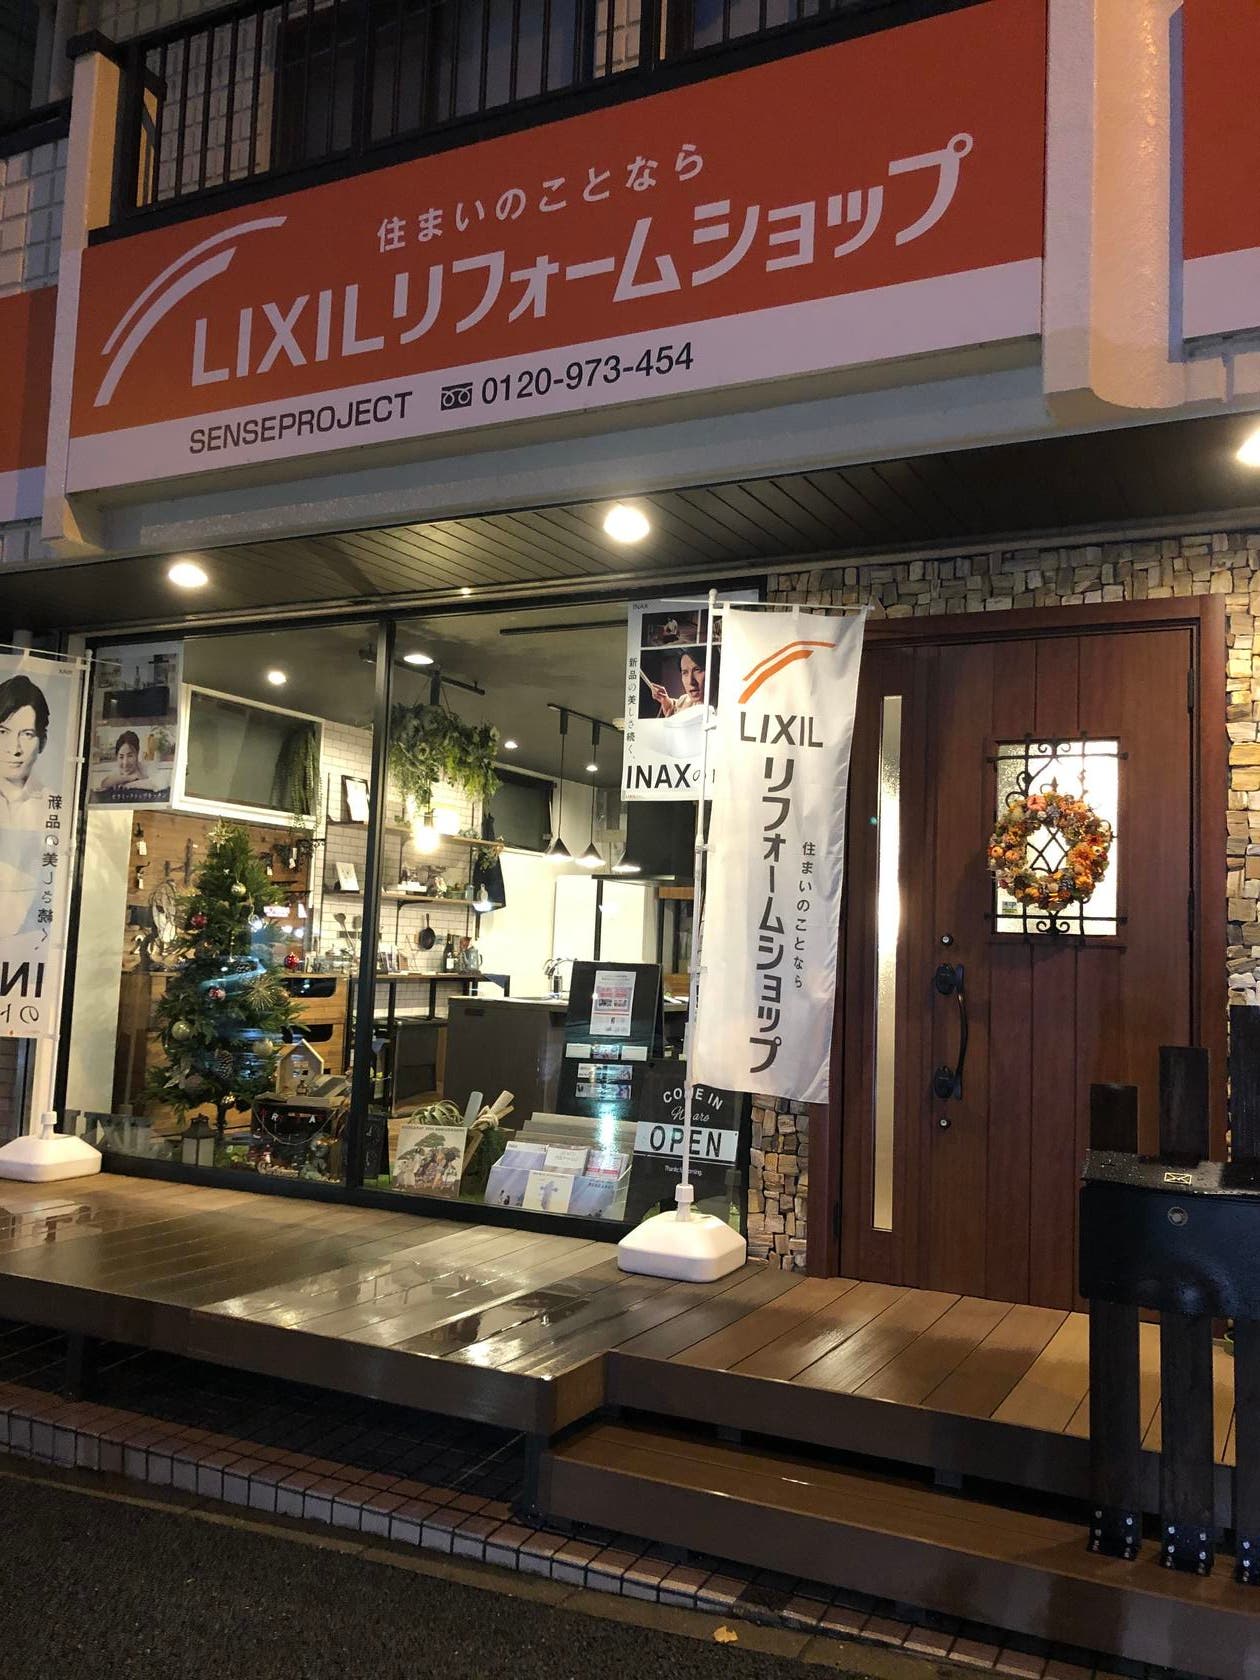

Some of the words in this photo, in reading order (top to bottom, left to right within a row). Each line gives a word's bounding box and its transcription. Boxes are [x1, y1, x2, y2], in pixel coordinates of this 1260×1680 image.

[377, 143, 704, 253] 住まいのことなら
[480, 342, 694, 405] 0120-973-454
[189, 391, 413, 455] SENSEPROJECT
[739, 711, 824, 749] LIXIL
[749, 757, 795, 1073] リフォームショップ
[793, 841, 816, 989] 住まいのことなら
[663, 1087, 704, 1103] COE
[707, 1093, 723, 1110] IN
[649, 1125, 722, 1158] OPEN
